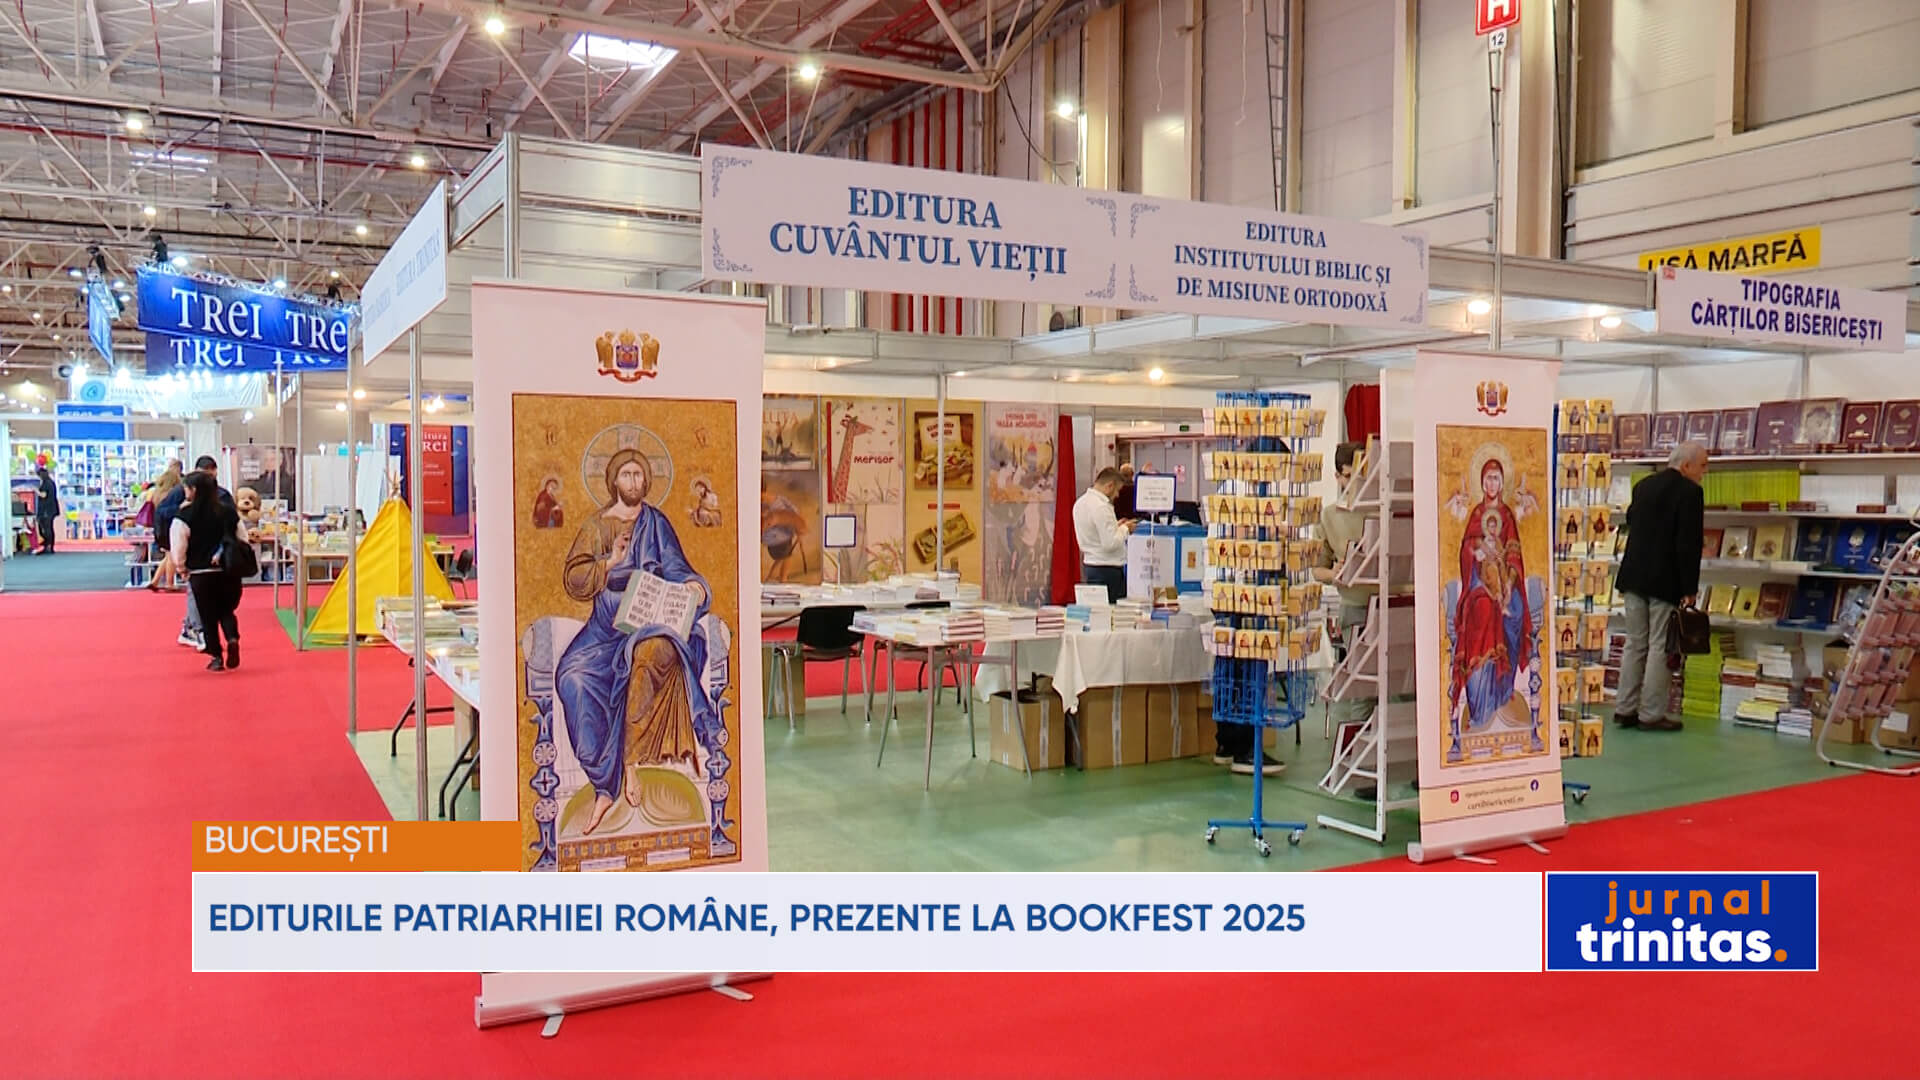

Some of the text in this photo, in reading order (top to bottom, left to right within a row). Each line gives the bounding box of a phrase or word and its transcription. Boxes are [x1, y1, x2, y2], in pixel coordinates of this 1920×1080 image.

[1491, 32, 1504, 46] 12
[848, 187, 1002, 229] EDITURA
[770, 221, 1067, 281] CUVÂNTUL VIEȚII
[1245, 221, 1328, 248] EDITURA
[1708, 234, 1807, 271] MARFĂ
[1174, 244, 1391, 288] INSTITUTULUI BIBLIC ȘI
[1176, 276, 1389, 312] DE MISIUNE ORTODOXĂ
[1741, 279, 1841, 310] TIPOGRAFIA
[1691, 298, 1883, 345] CĂRȚILOR BISERICEȘTI
